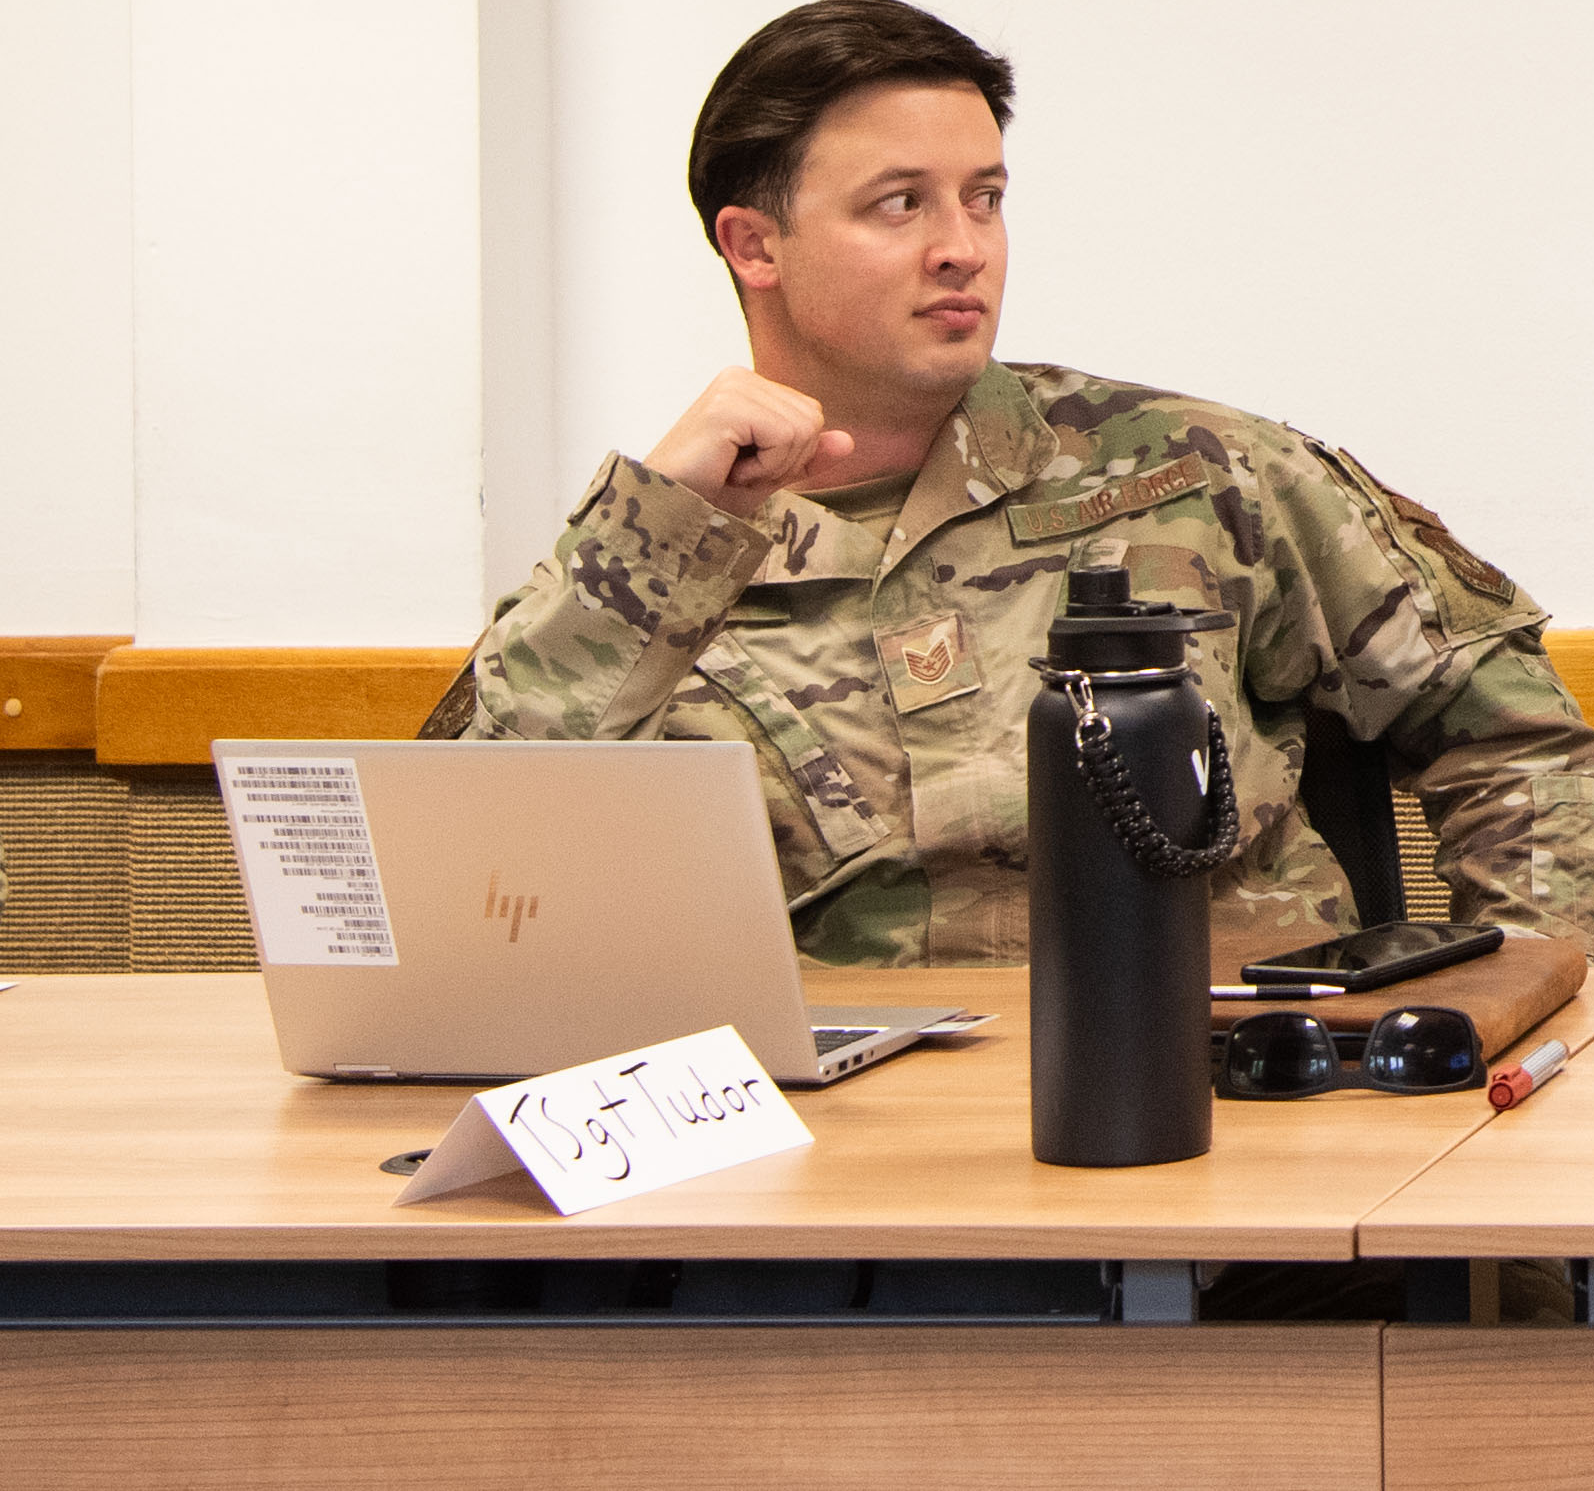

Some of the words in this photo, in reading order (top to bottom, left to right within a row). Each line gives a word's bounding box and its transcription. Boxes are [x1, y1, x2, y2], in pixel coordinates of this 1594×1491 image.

[1079, 488, 1117, 525] AIR
[510, 1093, 636, 1181] TSgt
[618, 1061, 761, 1140] Tudor
